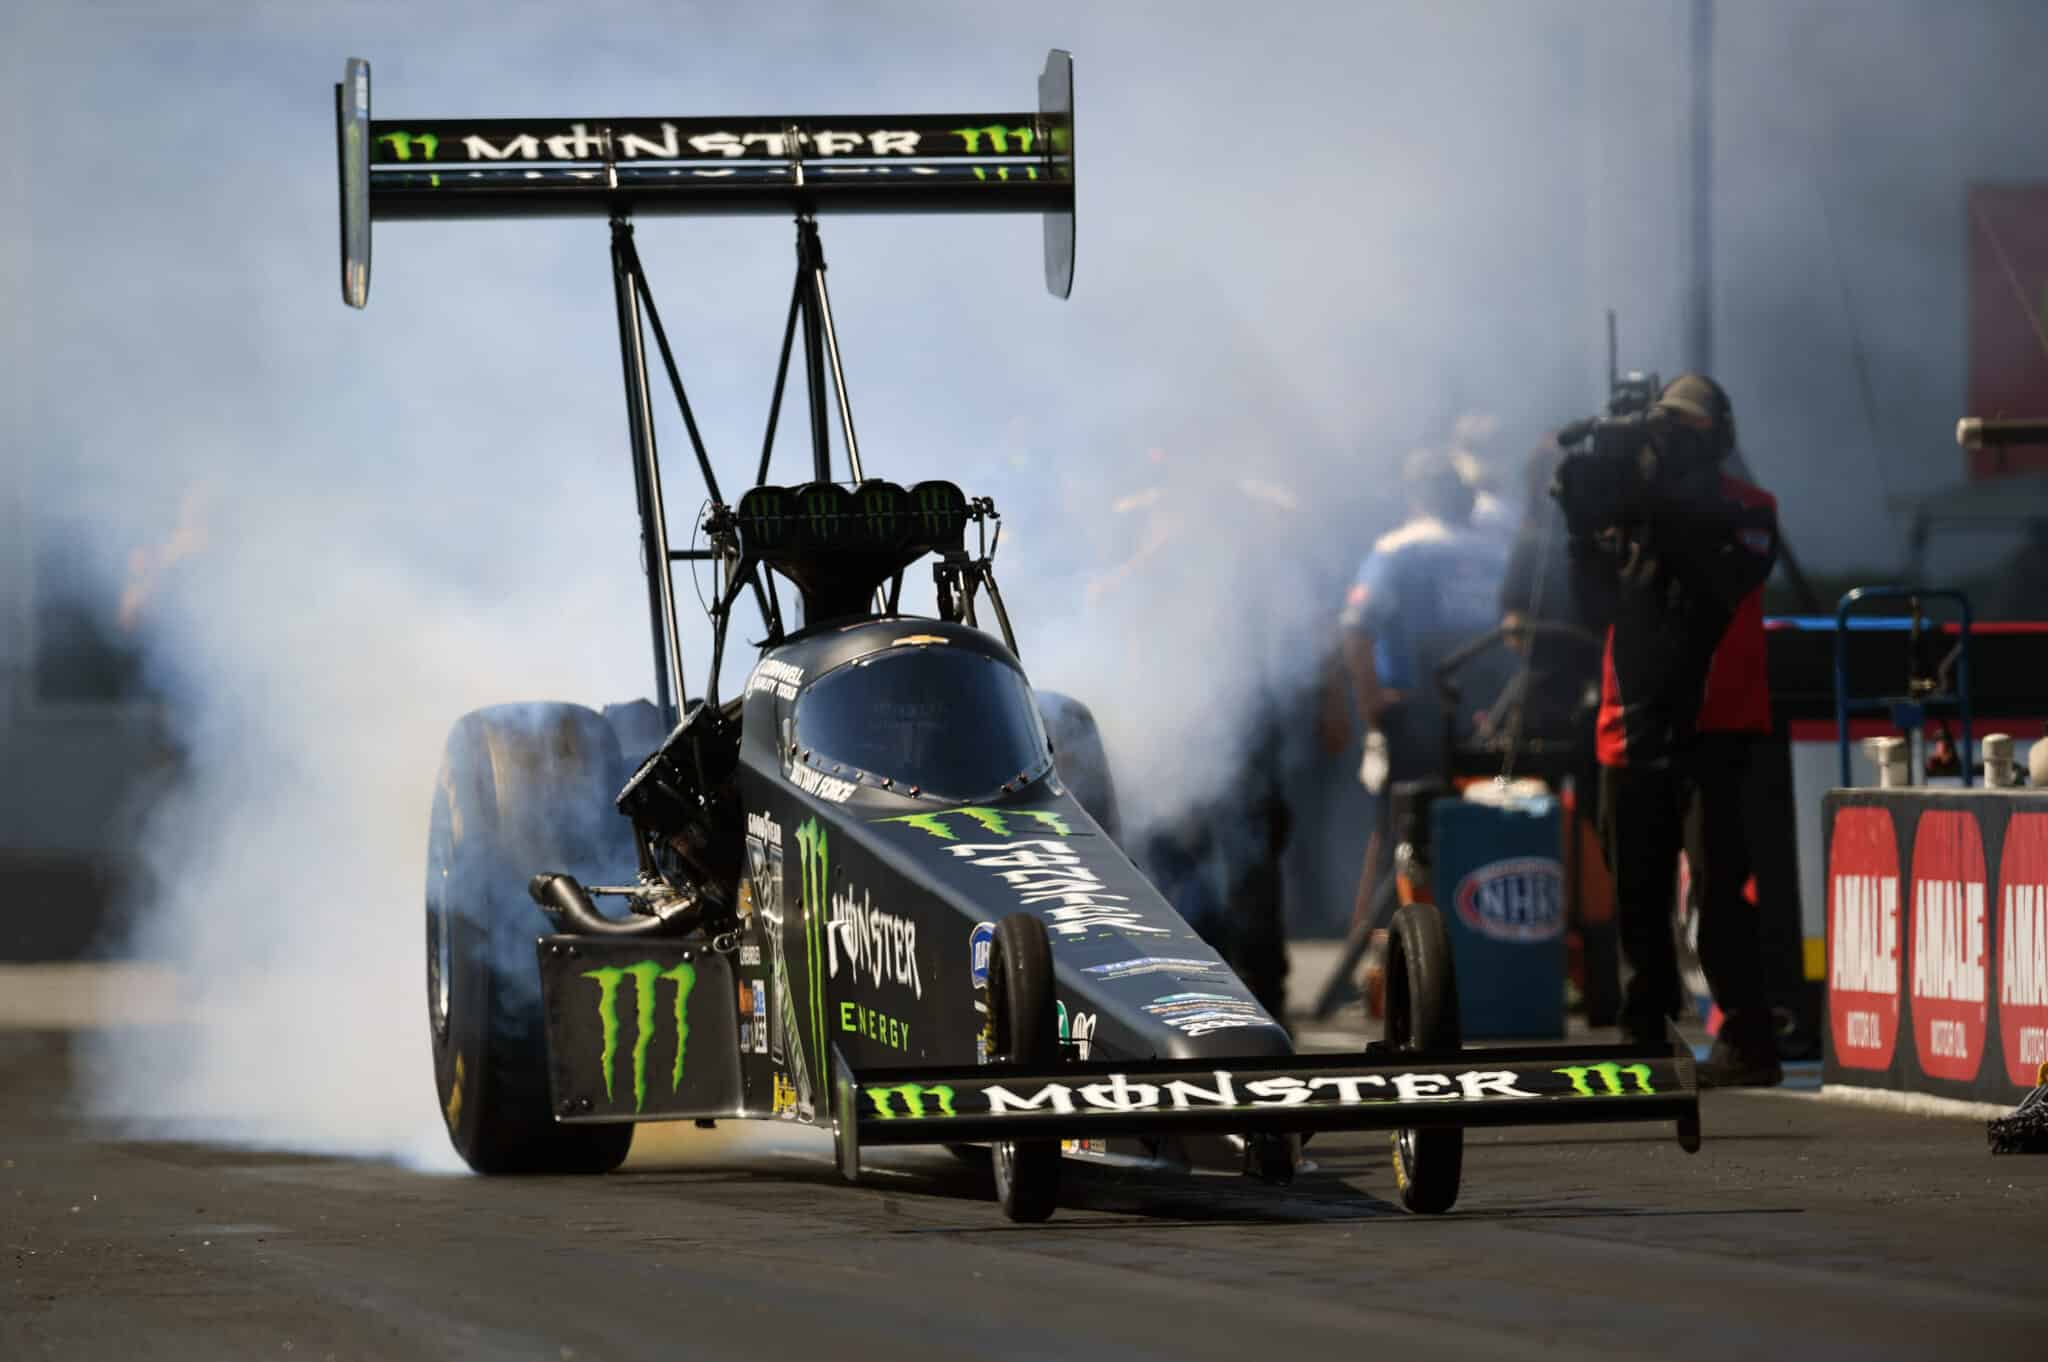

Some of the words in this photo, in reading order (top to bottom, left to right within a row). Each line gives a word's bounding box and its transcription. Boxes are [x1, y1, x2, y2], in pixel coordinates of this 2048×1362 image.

[463, 122, 921, 160] MONSTER
[827, 883, 922, 1000] MONSTER
[840, 1002, 909, 1051] ENERGY
[981, 1071, 1542, 1114] MONSTER
